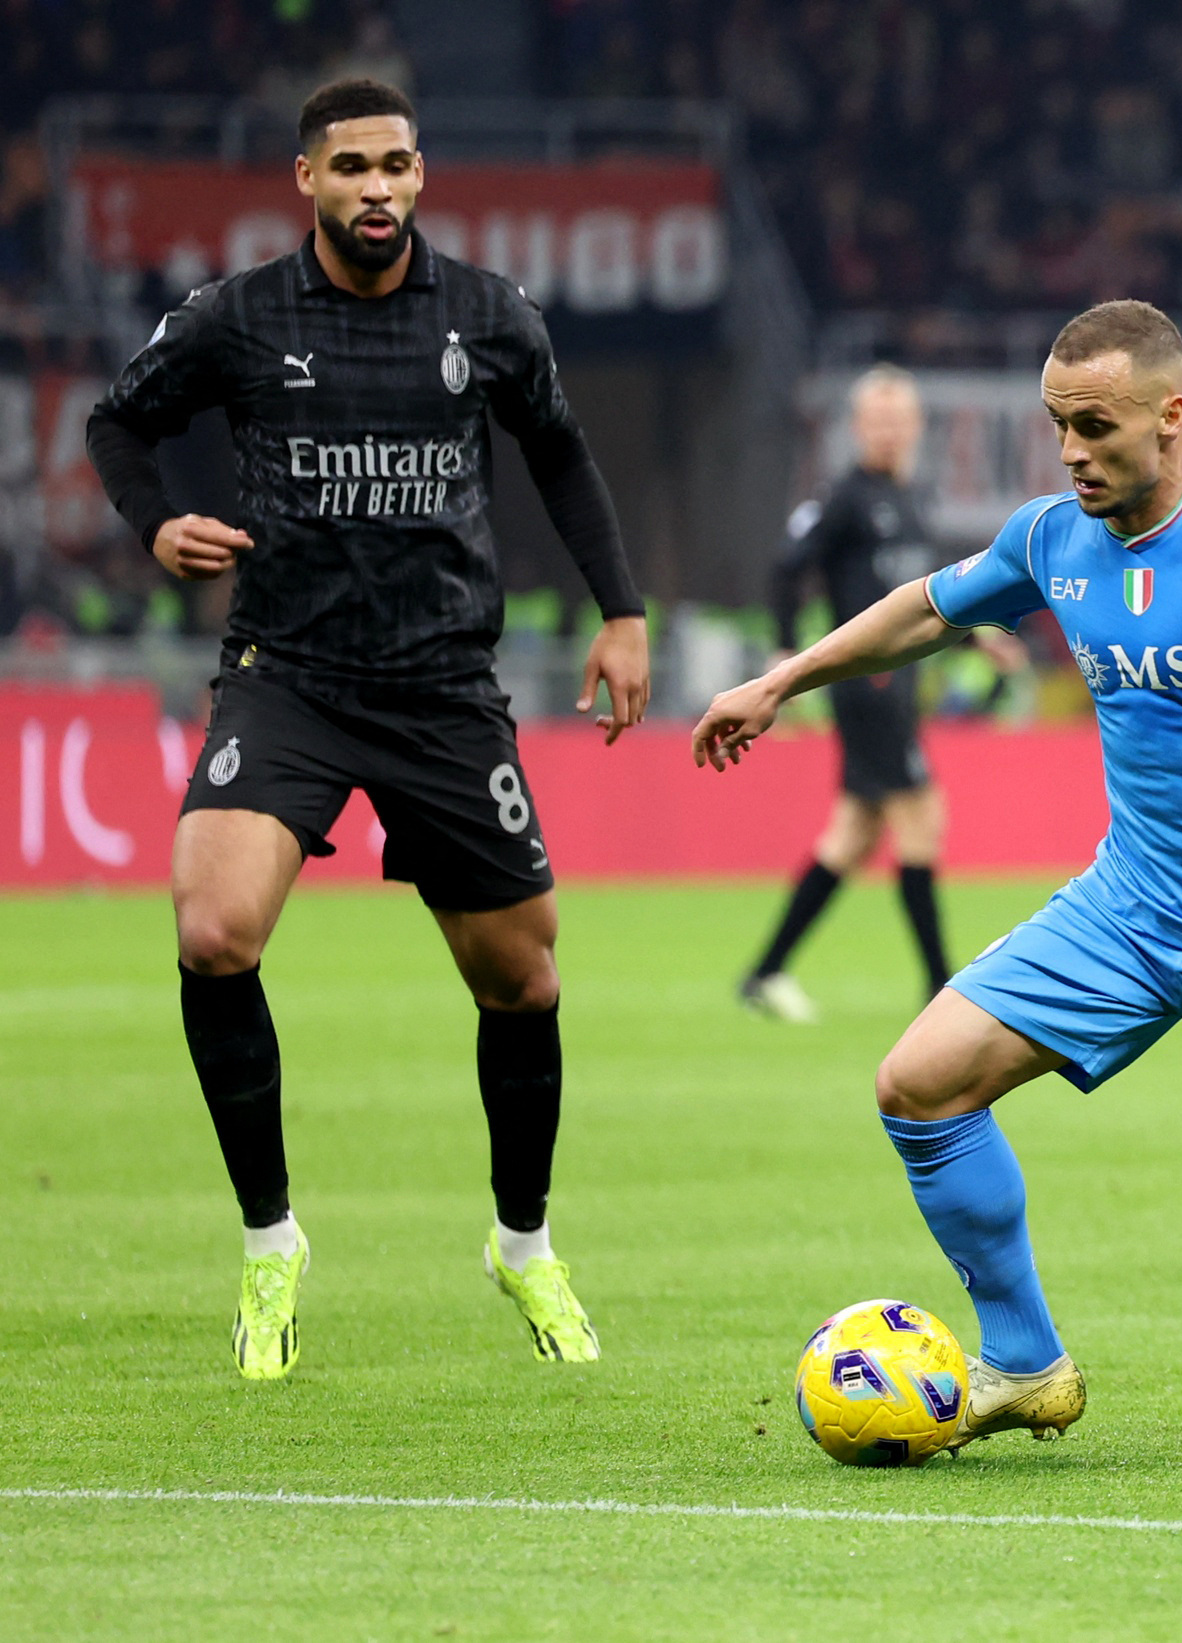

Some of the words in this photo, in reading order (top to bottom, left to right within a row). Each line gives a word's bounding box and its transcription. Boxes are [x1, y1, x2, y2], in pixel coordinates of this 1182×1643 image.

[287, 434, 464, 478] Emirates
[319, 482, 360, 516] FLY
[367, 481, 447, 516] BETTER
[1051, 577, 1089, 601] EA7
[489, 763, 529, 834] 8
